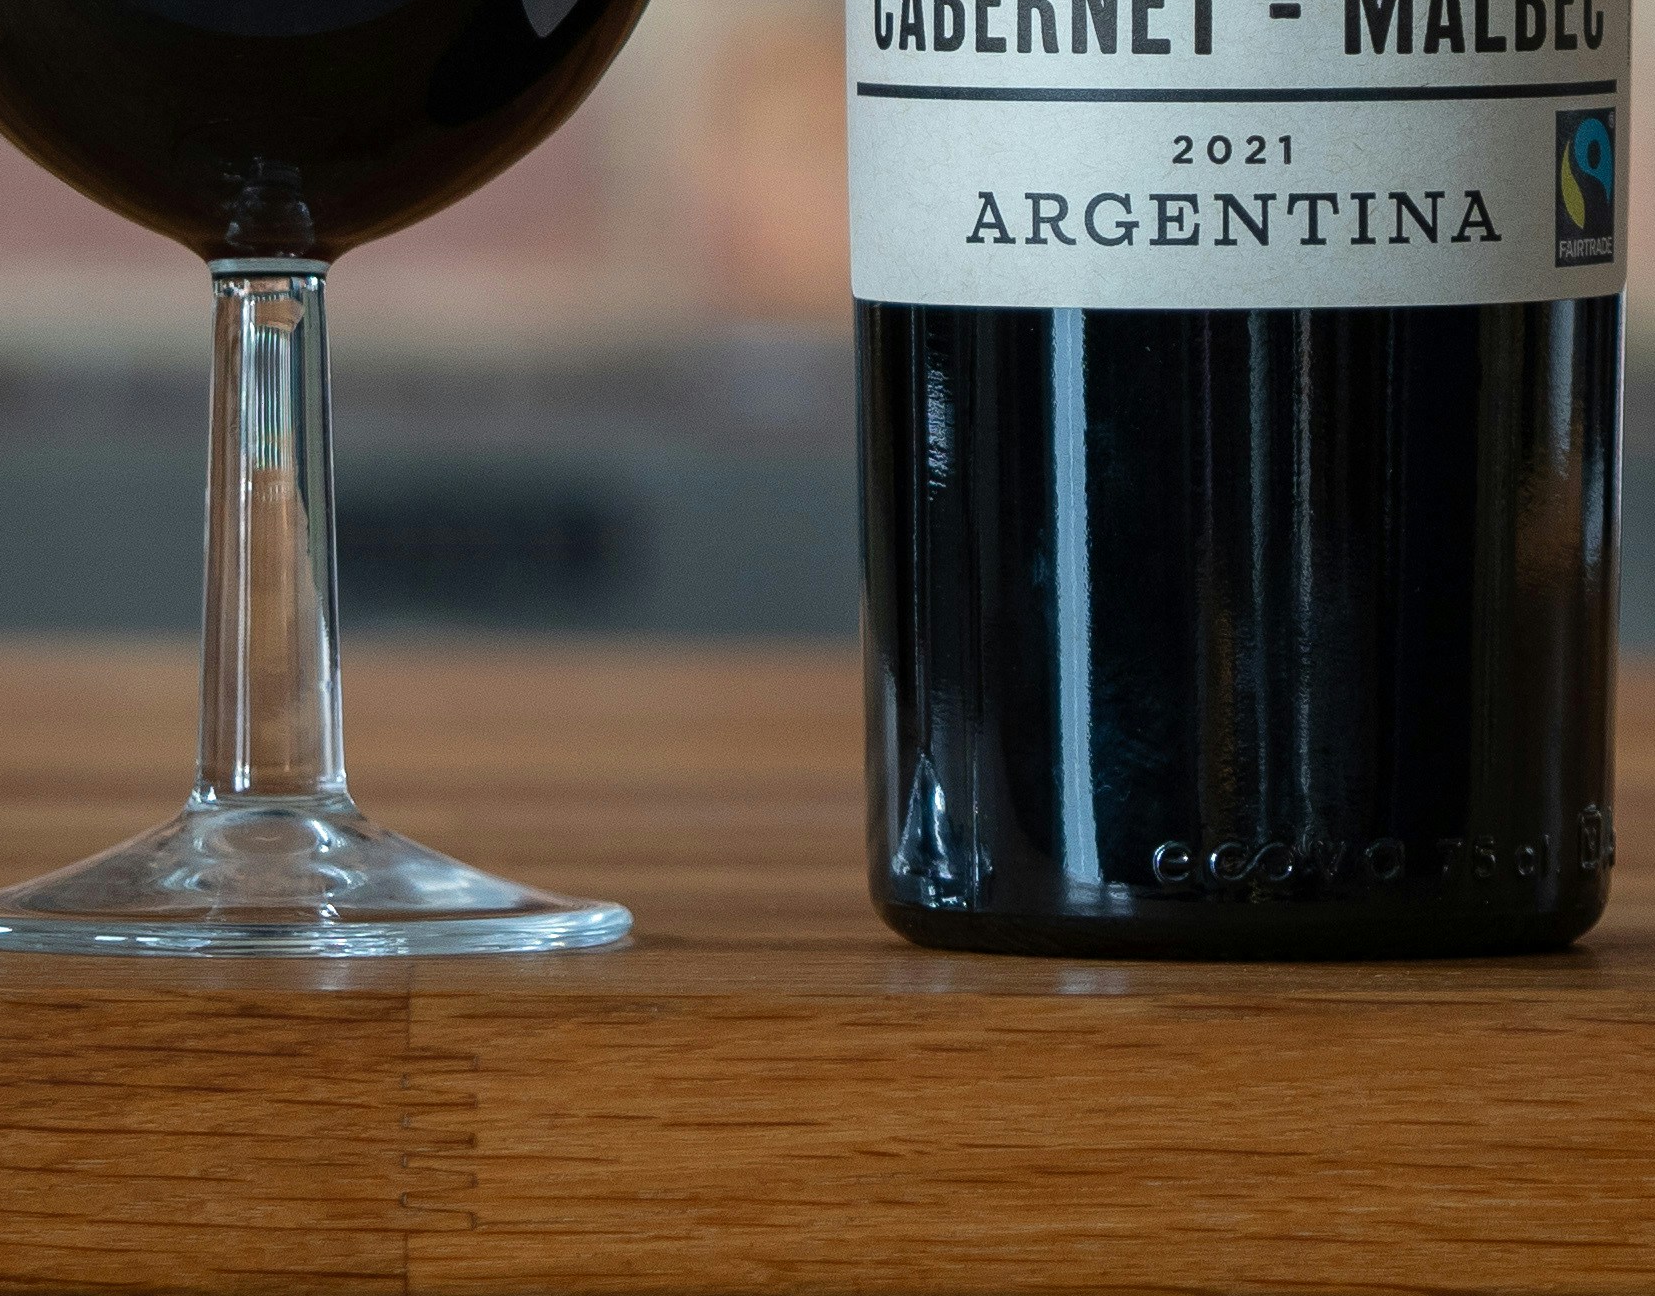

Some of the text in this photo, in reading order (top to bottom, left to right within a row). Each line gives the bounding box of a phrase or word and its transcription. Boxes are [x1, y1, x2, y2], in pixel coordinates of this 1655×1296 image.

[1268, 2, 1303, 20] -
[1171, 133, 1295, 166] 2021
[965, 189, 1503, 247] ARGENTINA
[1559, 236, 1613, 259] FAIRTRADE
